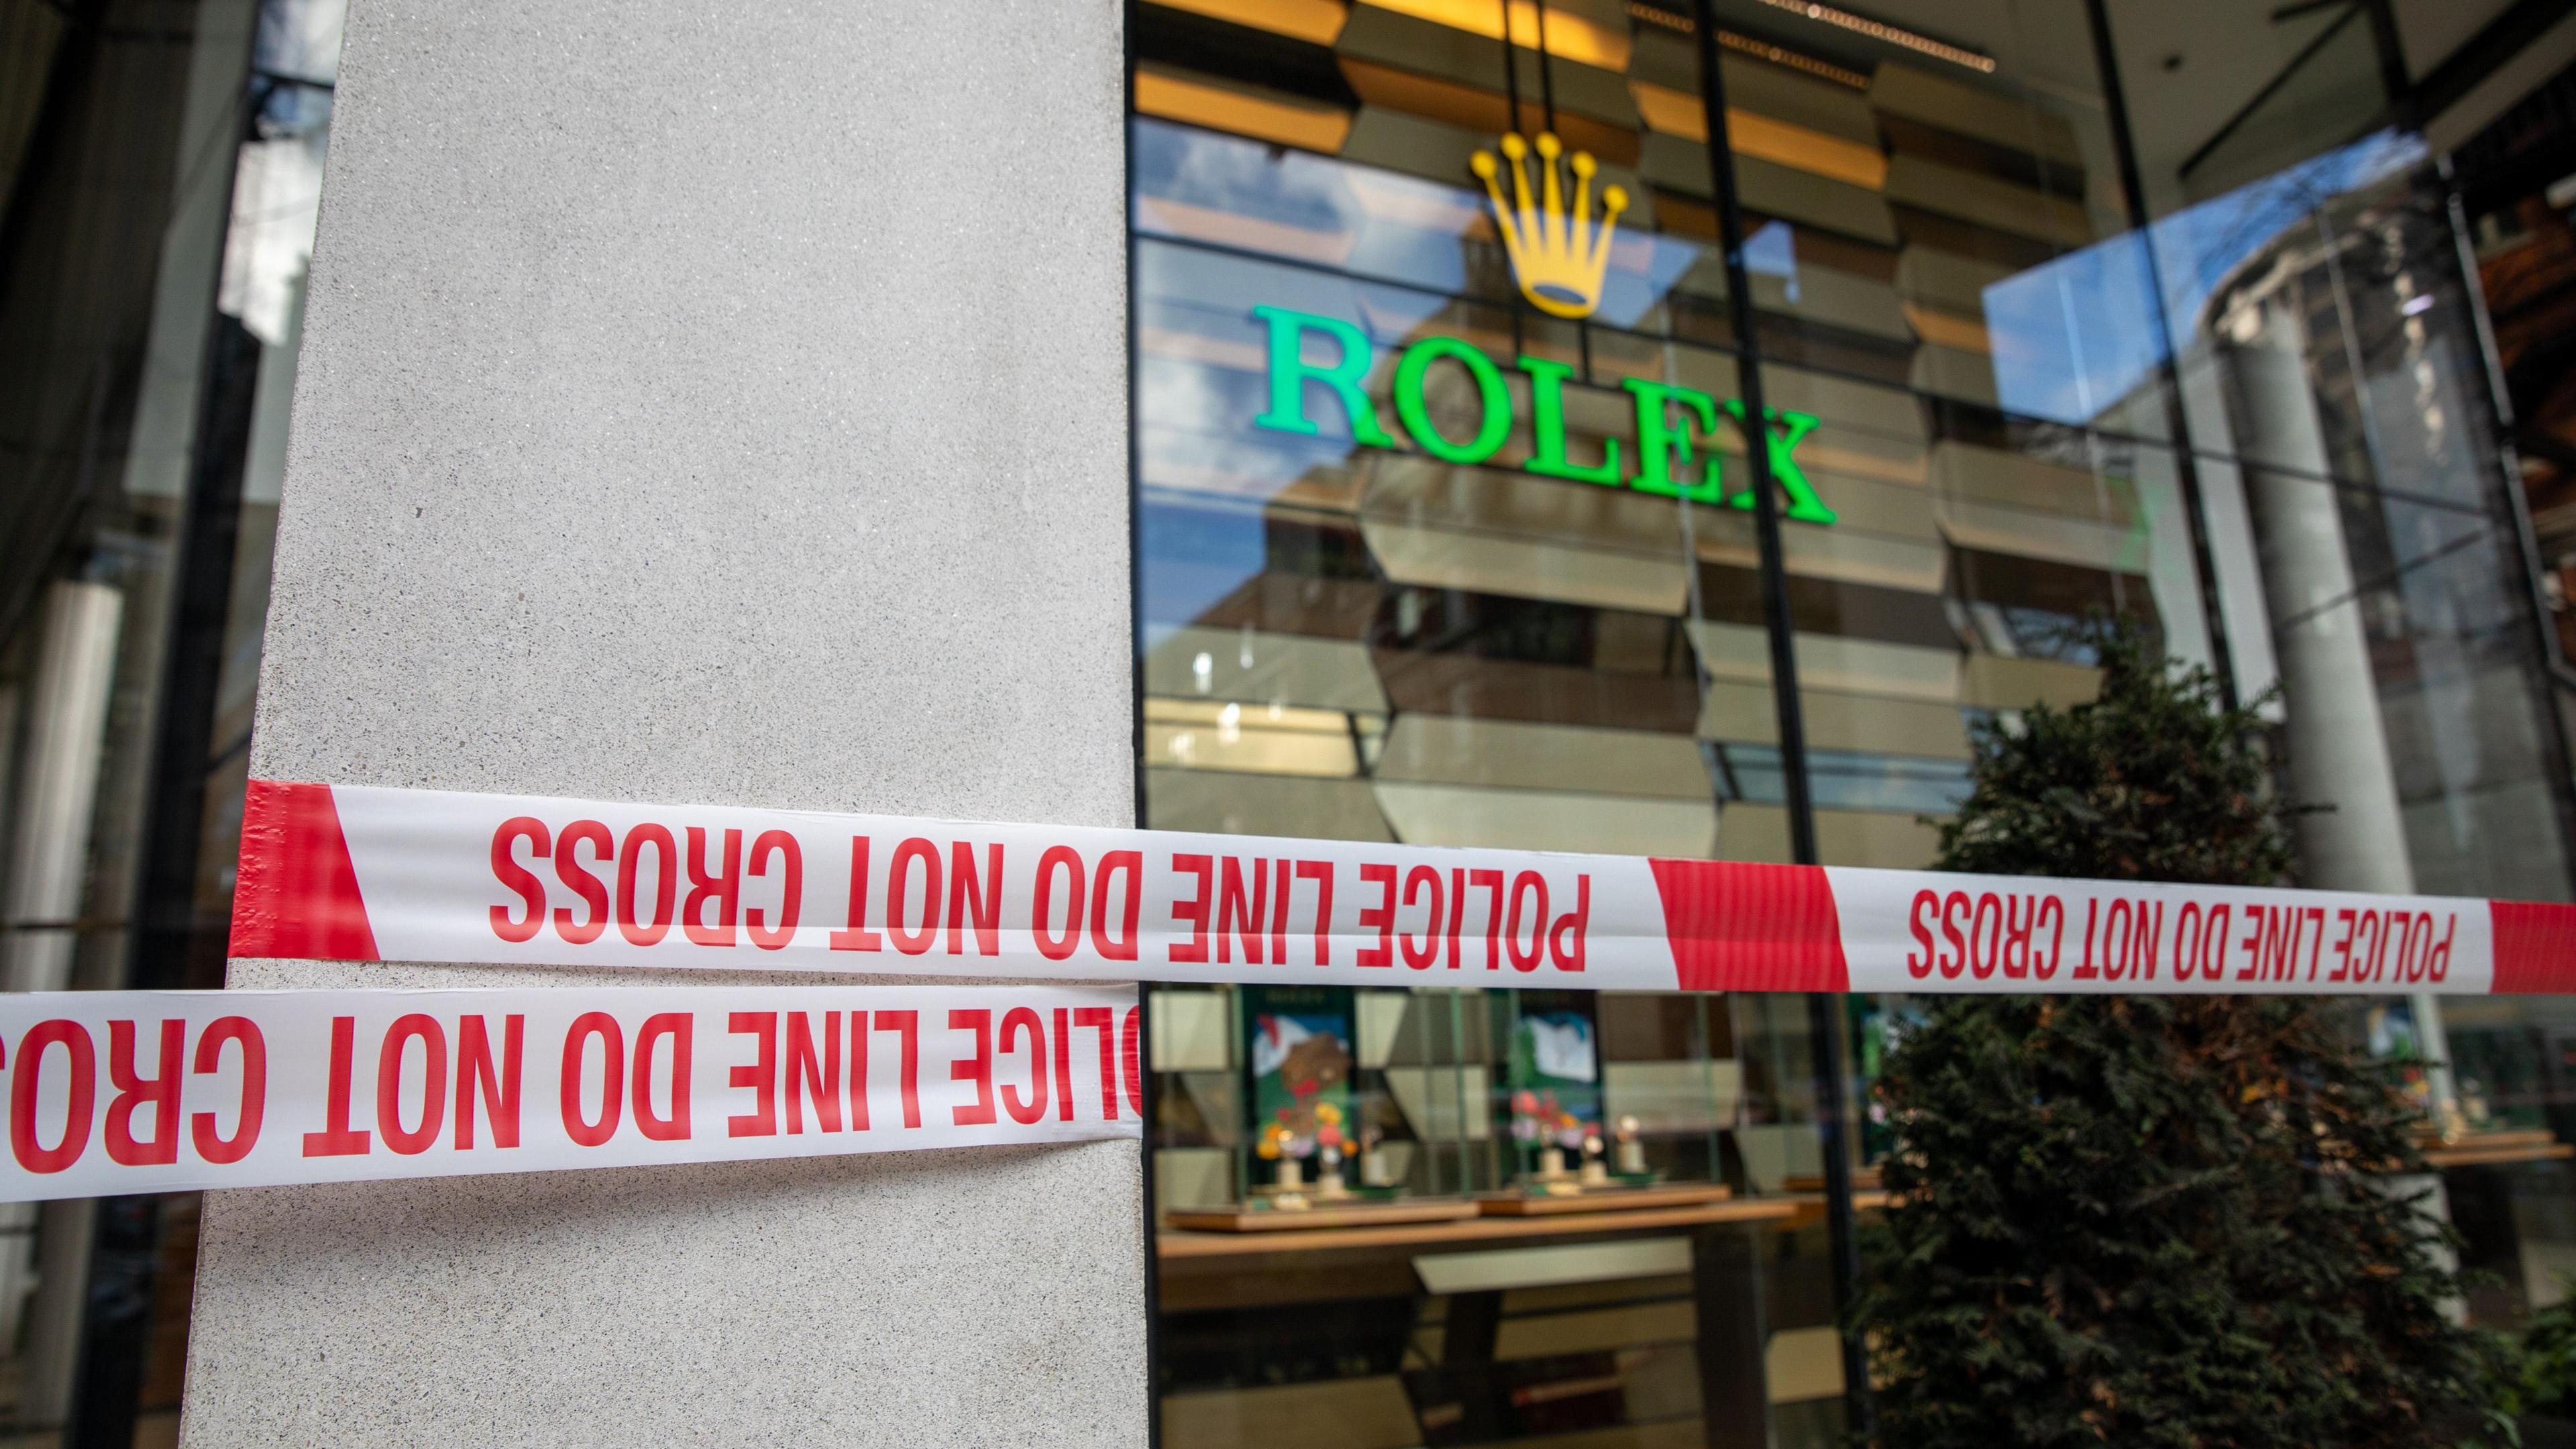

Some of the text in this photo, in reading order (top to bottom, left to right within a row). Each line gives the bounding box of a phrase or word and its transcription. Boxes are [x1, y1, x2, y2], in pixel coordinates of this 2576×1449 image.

[1252, 305, 1837, 525] ROLEX
[489, 816, 1590, 972] POLICE LINE DO NOT CROSS
[1907, 889, 2456, 983] POLICE LINE DO NOT CROSS
[0, 1016, 266, 1174] CRO
[302, 1013, 525, 1158] NOT
[560, 1012, 694, 1147] DO
[728, 1010, 922, 1138] LINE
